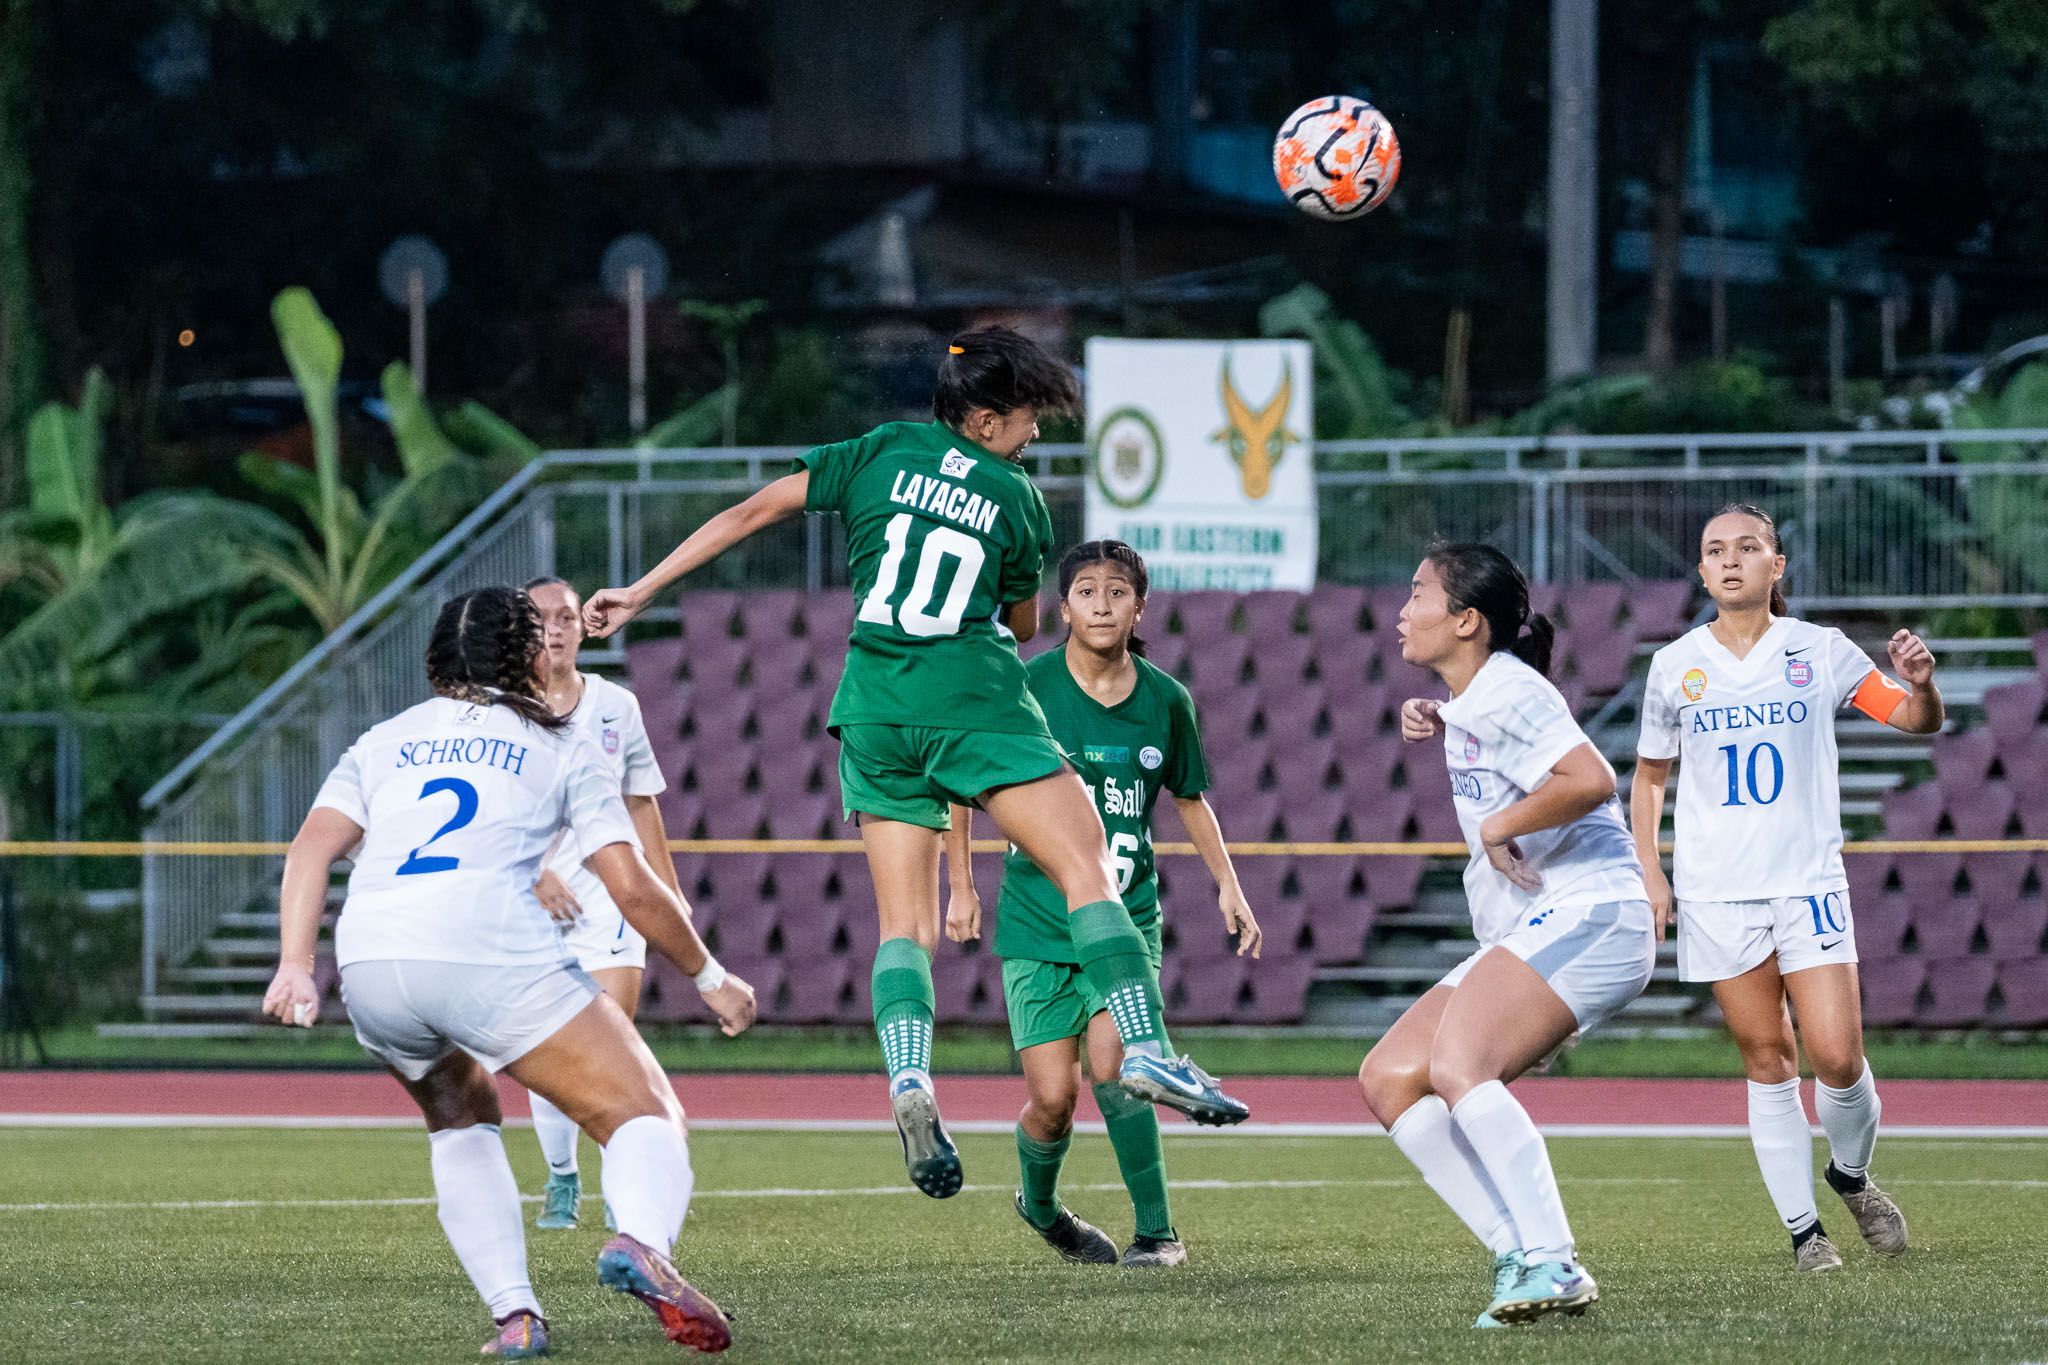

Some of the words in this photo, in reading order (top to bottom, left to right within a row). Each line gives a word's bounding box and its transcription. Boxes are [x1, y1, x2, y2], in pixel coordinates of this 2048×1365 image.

[890, 470, 1000, 534] LAYACAN
[858, 513, 985, 637] 10
[1693, 701, 1807, 733] ATENEO
[396, 737, 528, 775] SCHROTH
[1718, 742, 1784, 806] 10
[396, 777, 479, 876] 2
[1802, 893, 1846, 936] 10
